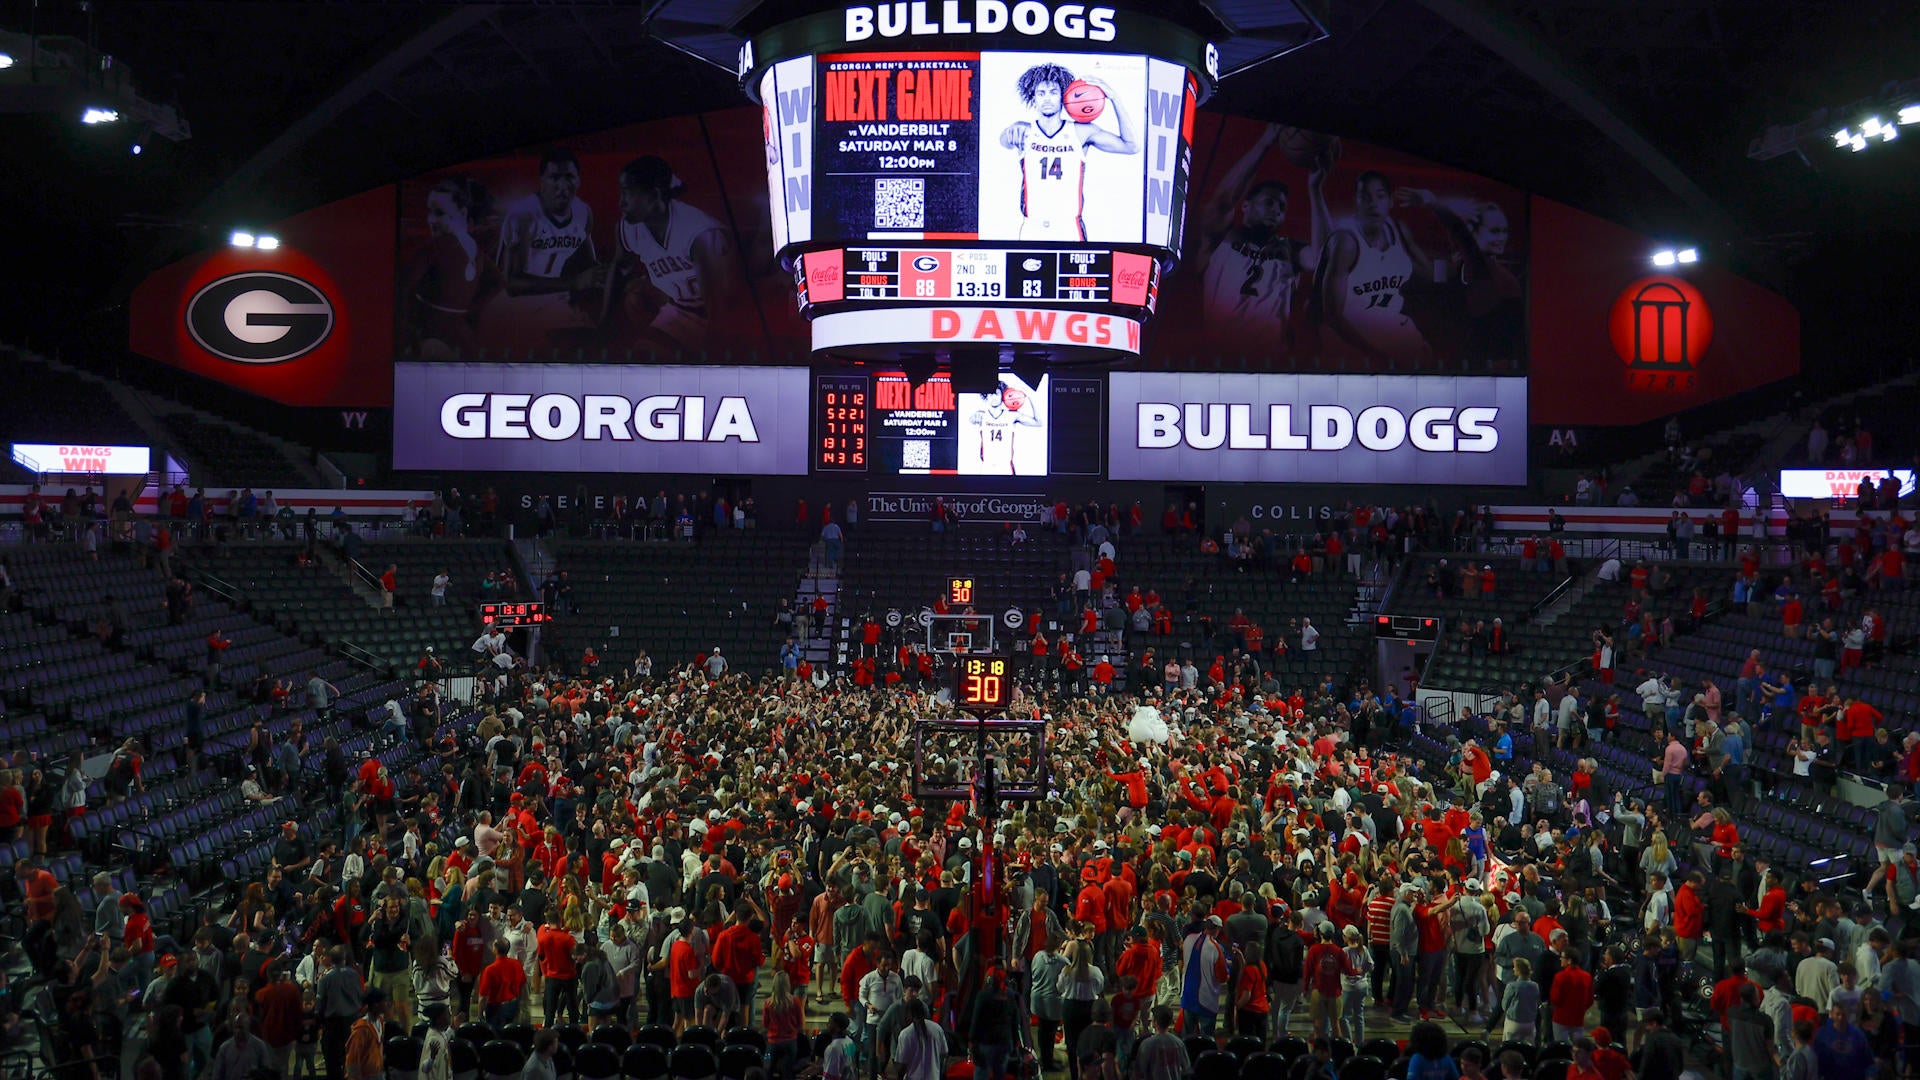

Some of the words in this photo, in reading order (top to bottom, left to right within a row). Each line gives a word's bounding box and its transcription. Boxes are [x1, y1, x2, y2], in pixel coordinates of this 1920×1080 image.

[845, 0, 1116, 42] BULLDOGS
[826, 71, 891, 122] NEXT
[896, 69, 972, 120] GAME
[858, 124, 950, 136] VANDERBILT
[839, 141, 909, 152] SATURDAY
[913, 140, 945, 151] MAR
[948, 140, 957, 151] 8
[1031, 143, 1074, 152] GEORGIA
[878, 156, 935, 168] 12:00PM
[1040, 157, 1063, 180] 14
[862, 251, 887, 261] FOULS
[1070, 253, 1095, 264] FOULS
[869, 262, 877, 271] 10
[957, 265, 975, 274] 2ND
[985, 265, 997, 274] 30
[1079, 264, 1087, 274] 10
[860, 276, 888, 285] BONUS
[1069, 278, 1096, 287] BONUS
[916, 279, 935, 296] 88
[957, 282, 1001, 297] 13:19
[1022, 280, 1041, 297] 83
[932, 309, 1111, 345] DAWGS
[828, 393, 835, 405] 0
[853, 394, 864, 405] 12
[876, 381, 911, 409] NEXT
[915, 382, 955, 409] GAME
[440, 392, 760, 442] GEORGIA
[828, 408, 835, 419] 5
[838, 408, 846, 419] 2
[850, 409, 864, 419] 21
[341, 411, 368, 429] YY
[828, 423, 835, 433] 7
[853, 424, 864, 434] 14
[1137, 402, 1500, 453] BULLDOGS
[991, 429, 1002, 441] 14
[824, 438, 835, 448] 13
[856, 438, 864, 449] 3
[59, 447, 112, 456] DAWGS
[64, 458, 107, 471] WIN
[823, 453, 835, 463] 14
[838, 453, 846, 464] 3
[853, 453, 863, 464] 15
[868, 497, 897, 513] The
[970, 498, 988, 514] of
[952, 580, 972, 588] 13:18
[952, 588, 970, 602] 30
[967, 660, 1004, 676] 13:18
[967, 676, 999, 703] 30
